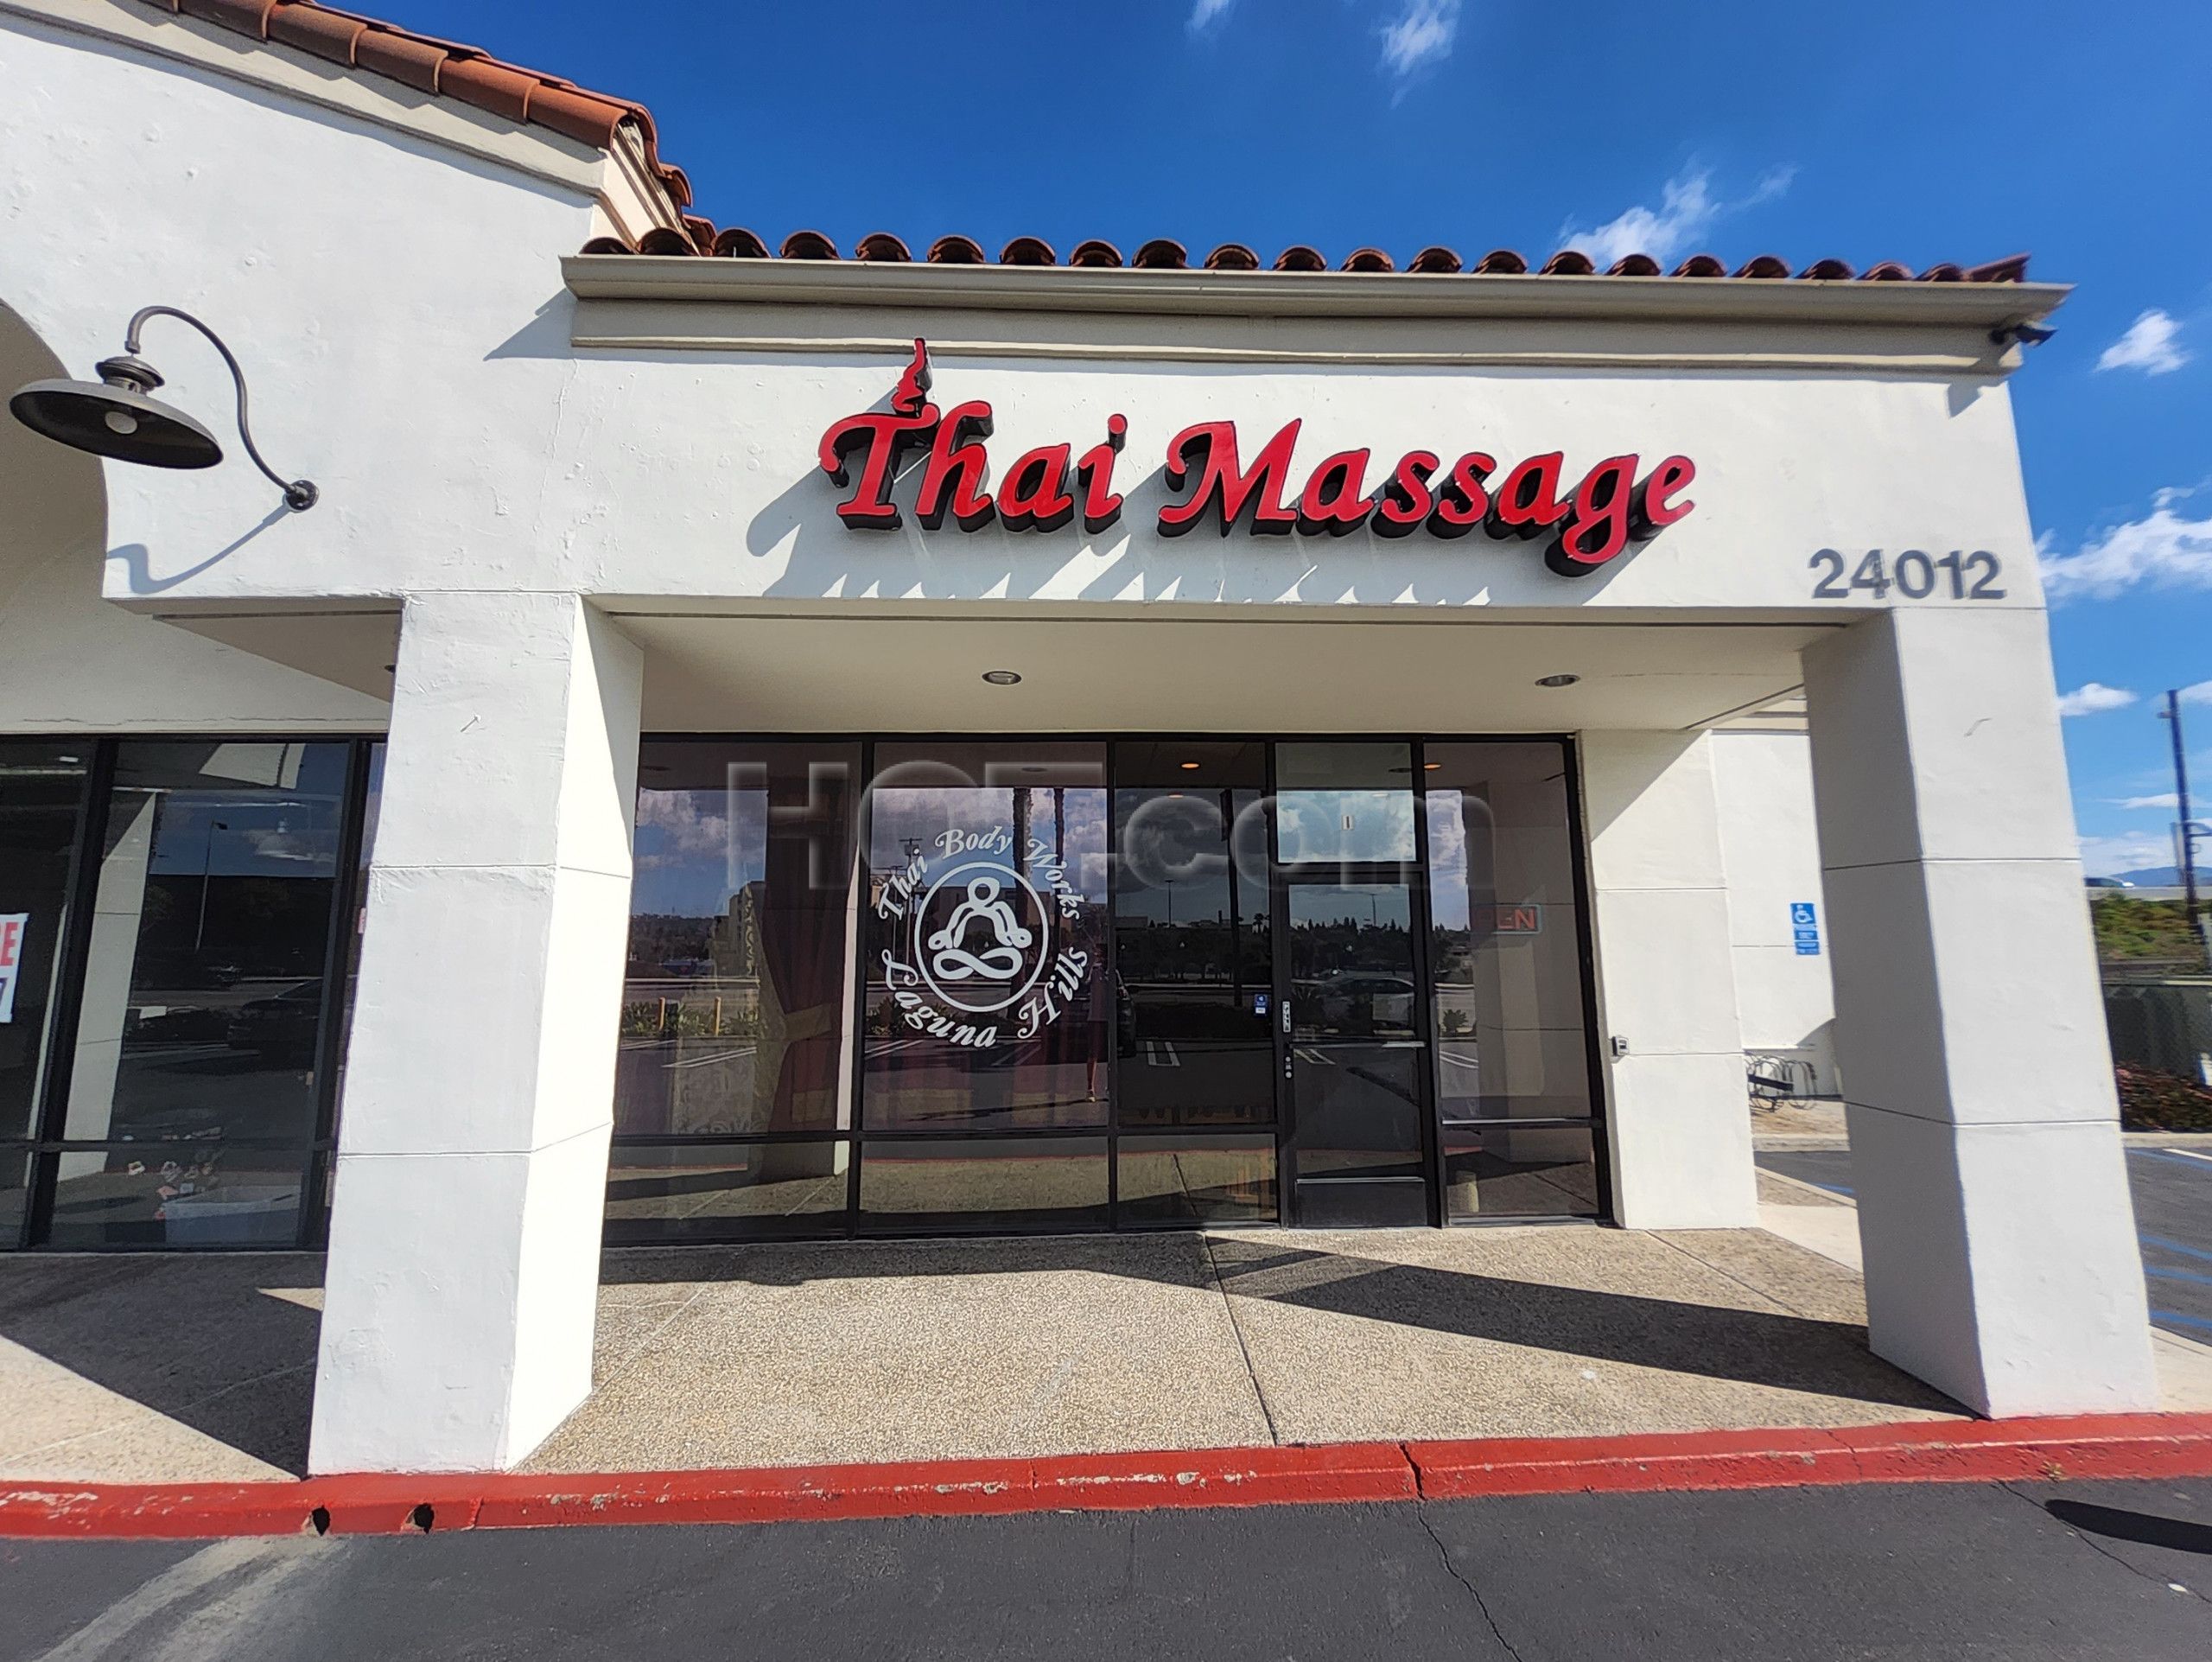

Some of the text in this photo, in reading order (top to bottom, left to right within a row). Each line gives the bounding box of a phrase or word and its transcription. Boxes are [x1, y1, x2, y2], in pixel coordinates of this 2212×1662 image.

[818, 339, 1697, 571] Thai Massage
[1808, 548, 2006, 600] 24012
[878, 825, 1085, 920] Thai Body Works
[0, 921, 18, 966] E
[881, 946, 1088, 1048] Laguna Hills
